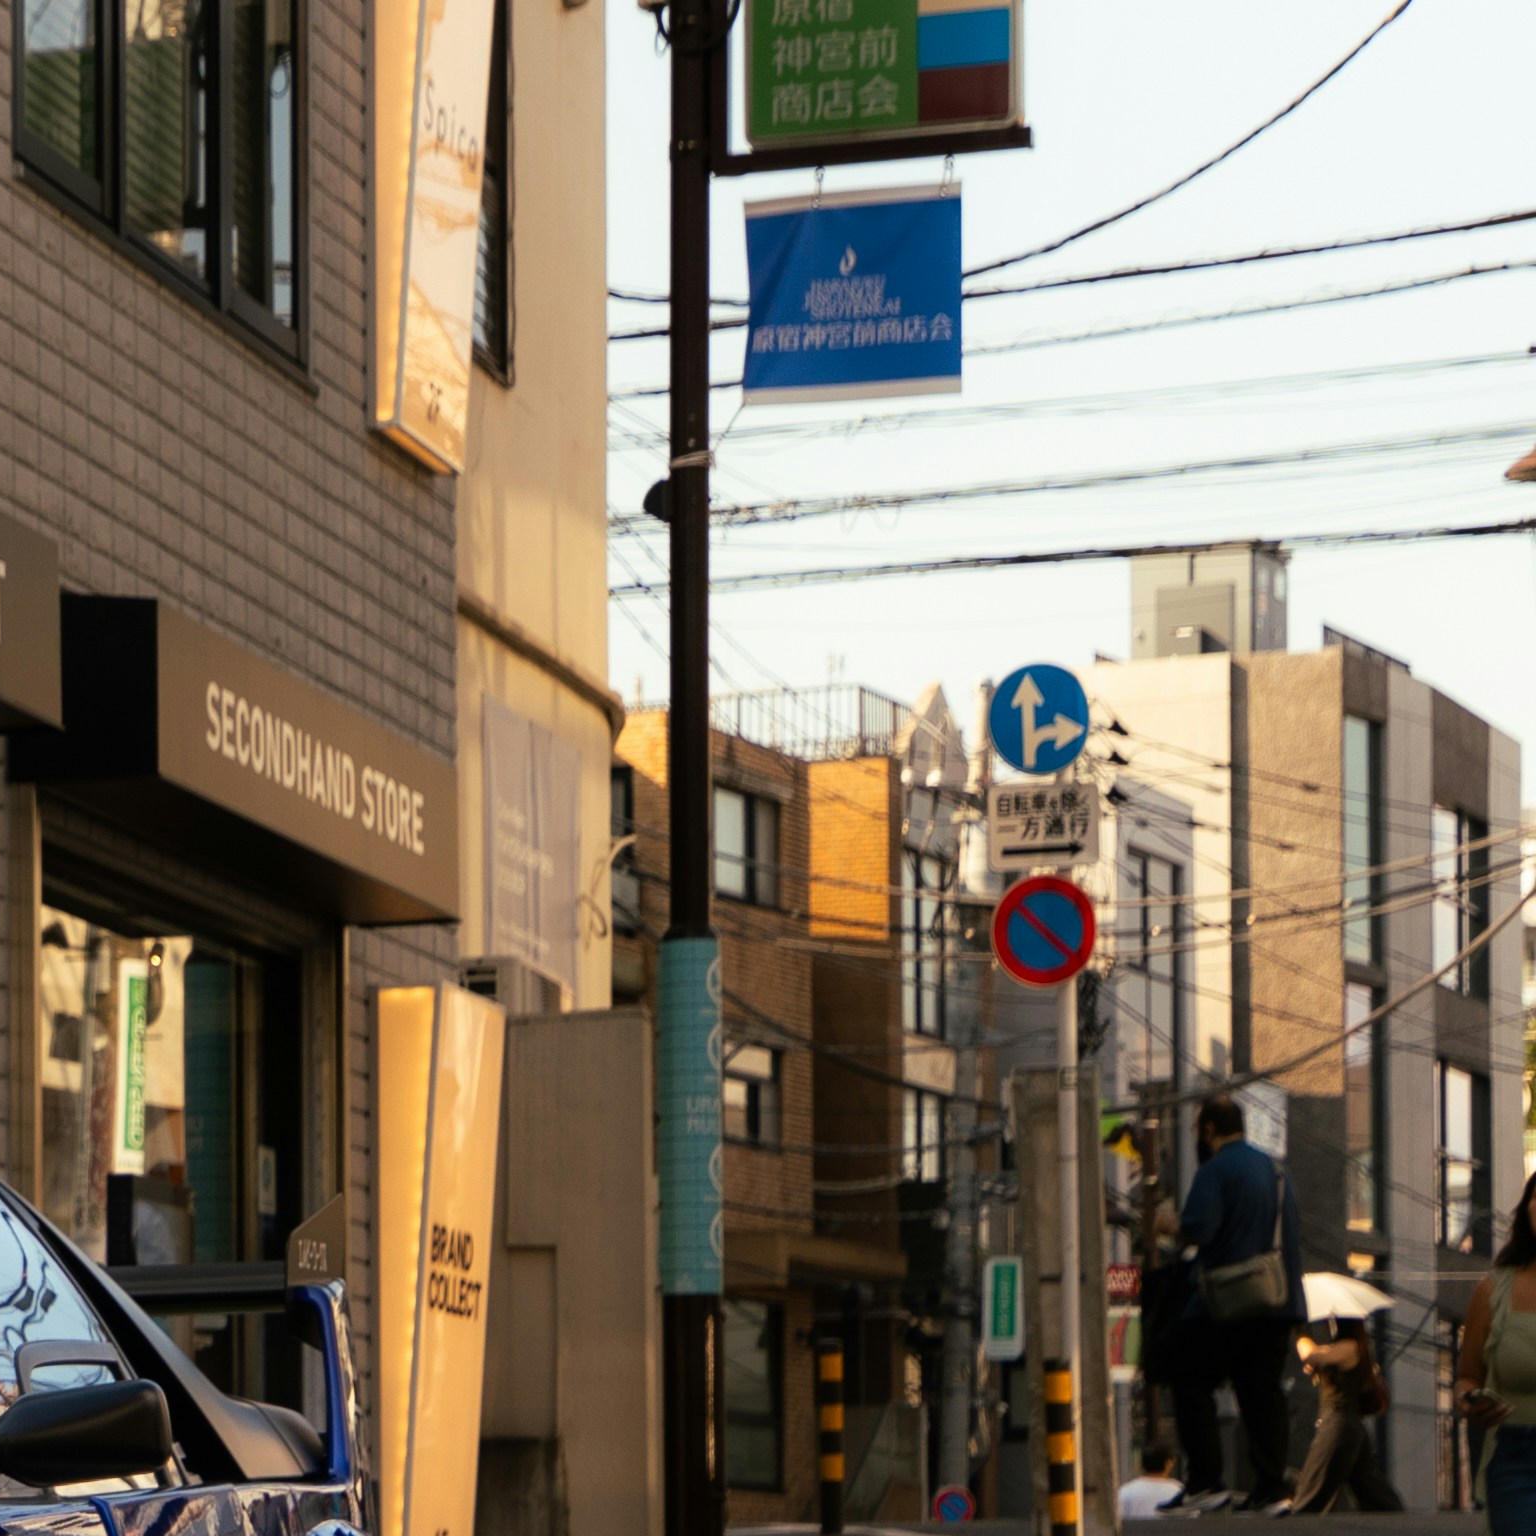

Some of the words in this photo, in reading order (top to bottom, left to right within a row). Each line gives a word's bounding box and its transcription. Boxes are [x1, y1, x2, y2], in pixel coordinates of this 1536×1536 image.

[772, 24, 898, 77] 神宮前
[772, 72, 898, 126] 商店会
[424, 79, 478, 174] Spica
[751, 312, 953, 353] 原宿神宮前商店会
[204, 680, 356, 820] SECONDHAND
[361, 764, 425, 856] STORE
[997, 813, 1089, 839] 一方通行
[431, 1223, 474, 1271] BRAND
[429, 1272, 481, 1320] COLLECT
